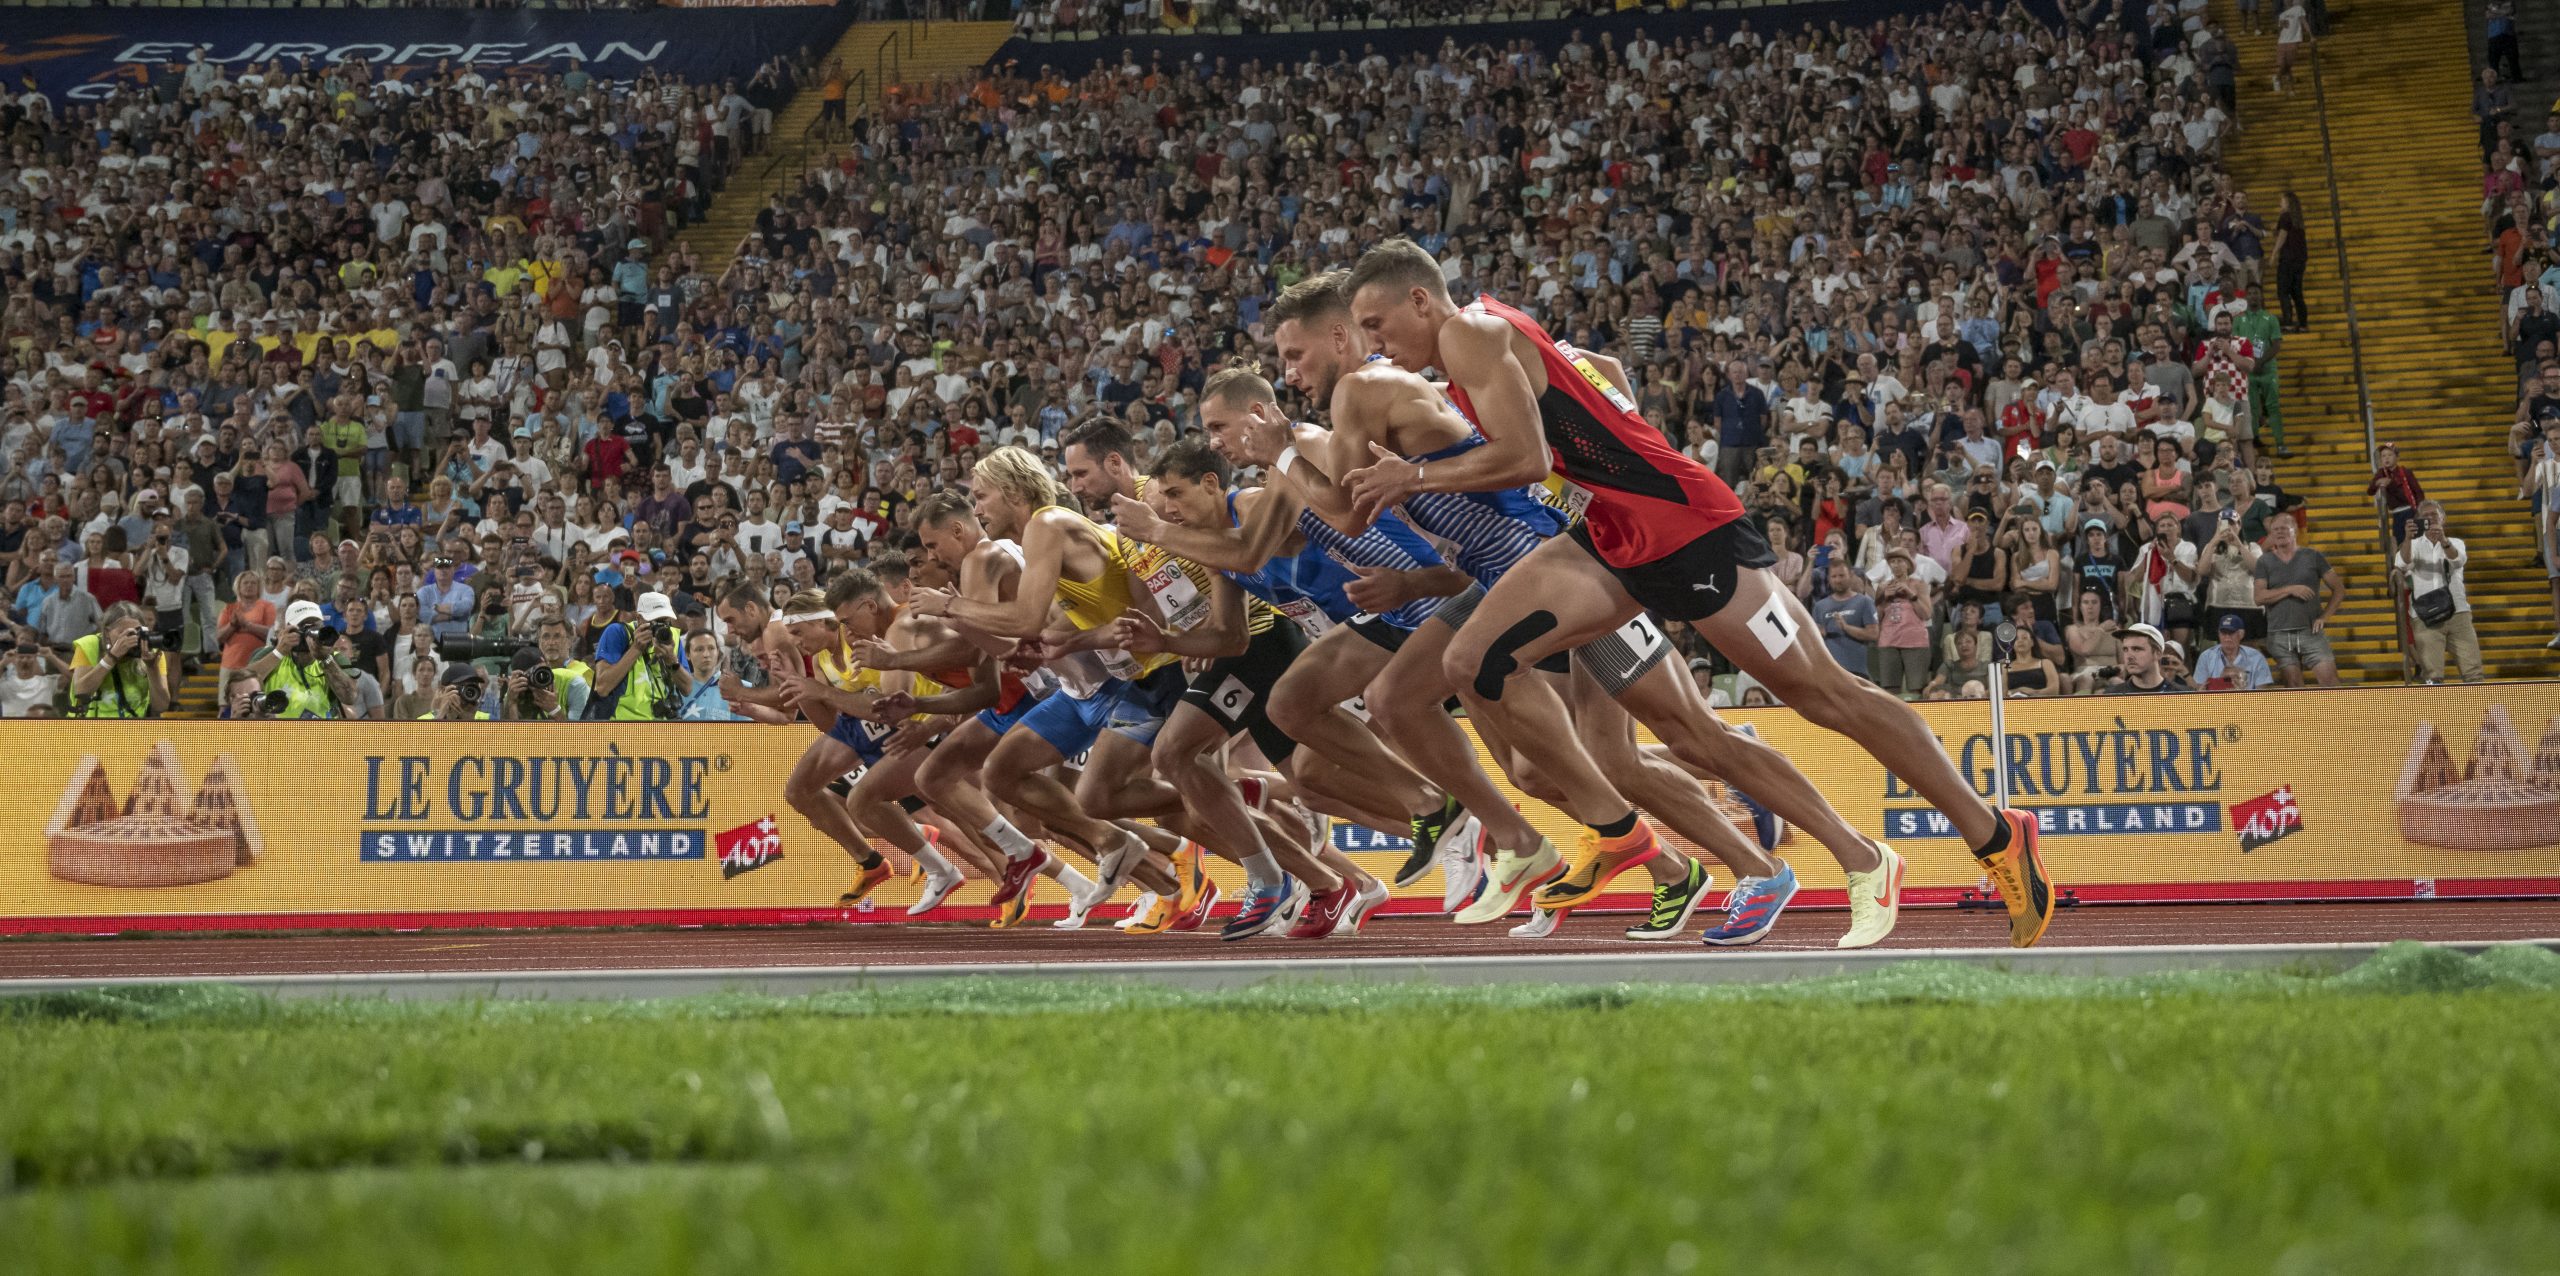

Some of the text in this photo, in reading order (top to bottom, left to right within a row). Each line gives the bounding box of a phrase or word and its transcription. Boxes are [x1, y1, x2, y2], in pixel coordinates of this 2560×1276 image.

[113, 41, 668, 63] EUROPEAN
[1146, 572, 1172, 592] PAR
[1165, 594, 1180, 608] 6
[1629, 619, 1655, 647] 2
[1765, 610, 1788, 638] 1
[1222, 688, 1243, 709] 6
[865, 721, 885, 736] 14
[362, 755, 432, 821] LE
[1899, 807, 2206, 834] SWERLAND
[2239, 805, 2299, 841] AOP
[376, 832, 691, 858] SWITZERLAND
[720, 834, 781, 870] AOP
